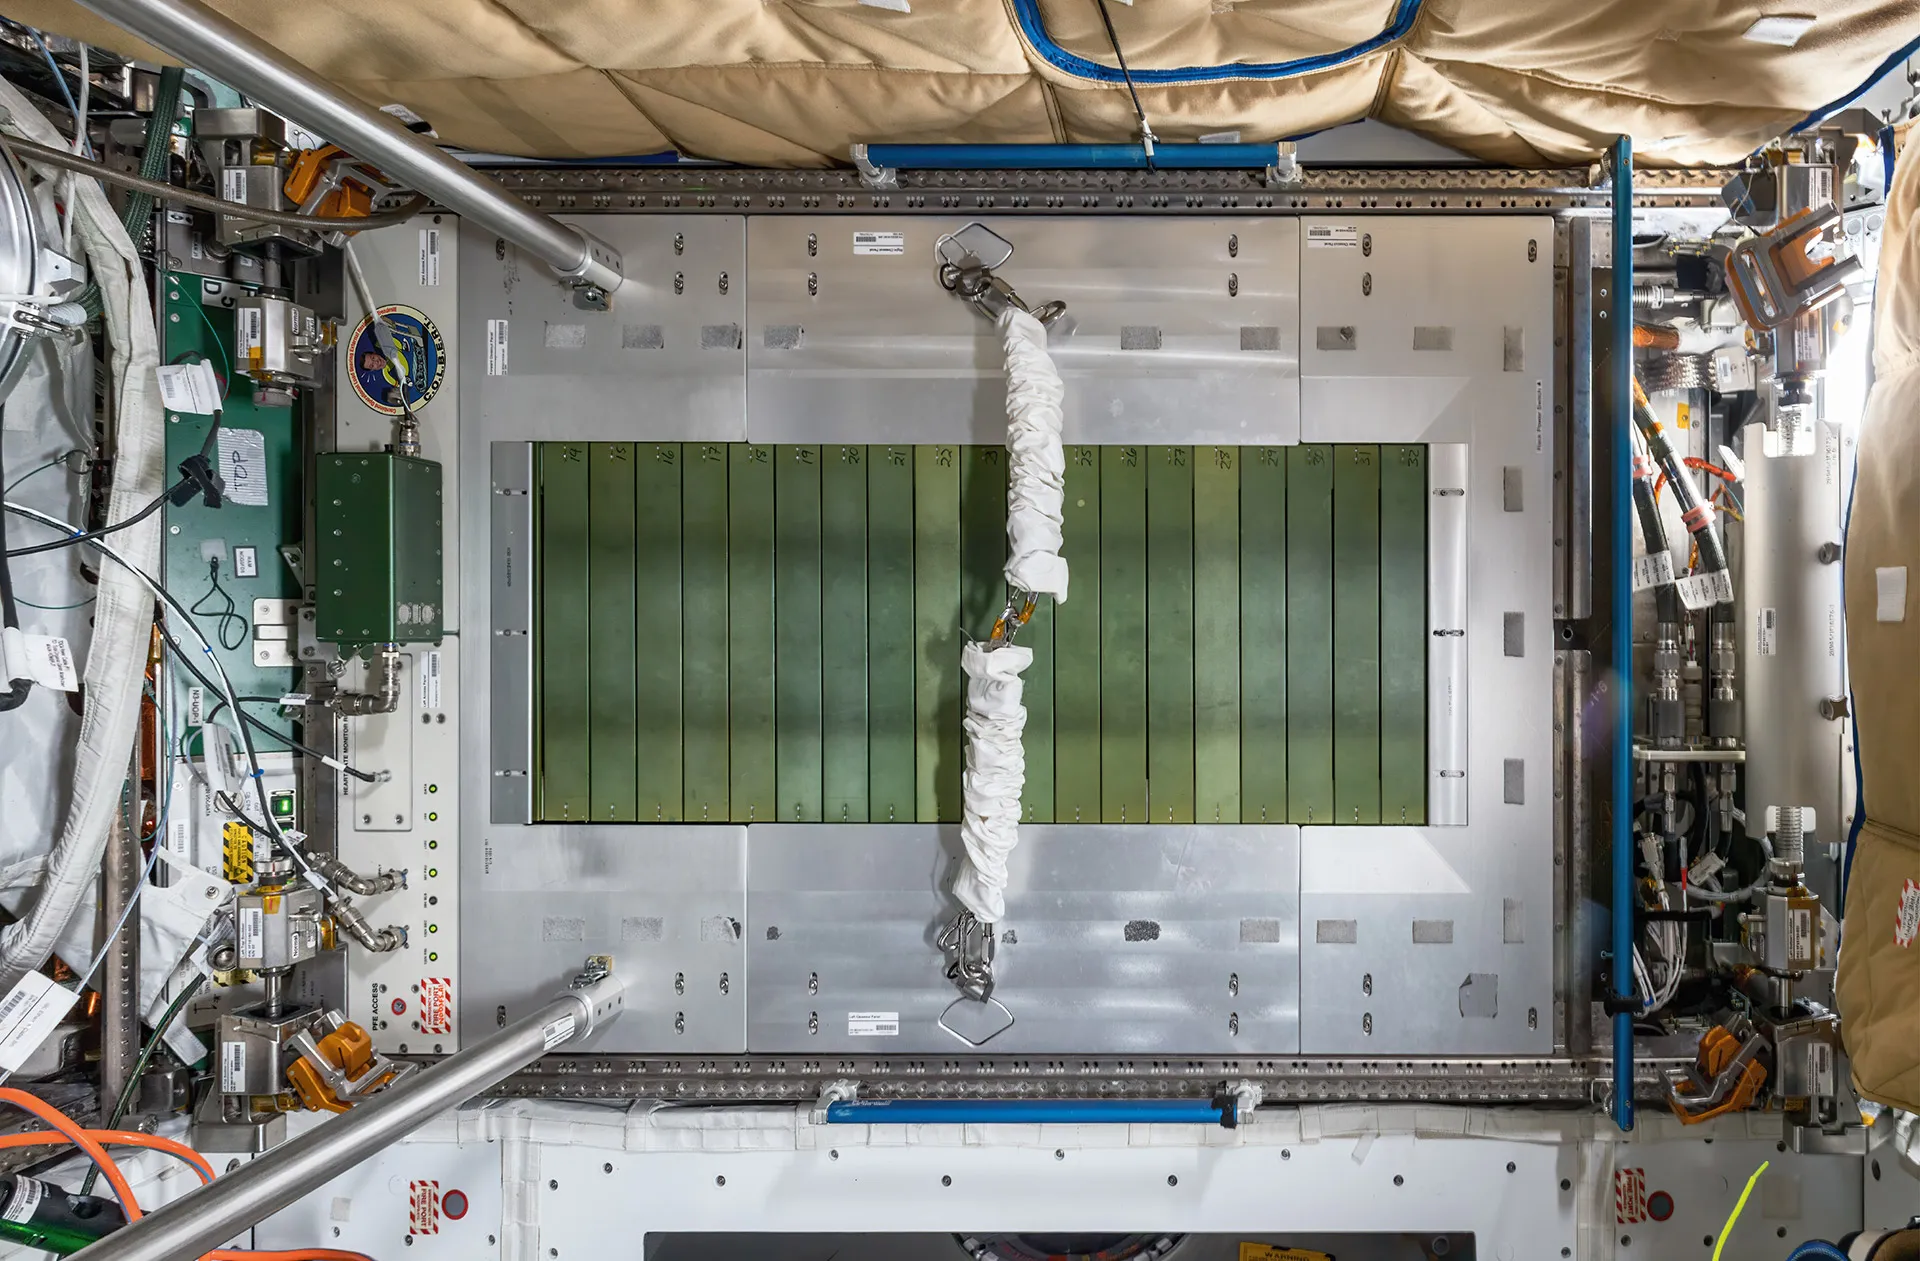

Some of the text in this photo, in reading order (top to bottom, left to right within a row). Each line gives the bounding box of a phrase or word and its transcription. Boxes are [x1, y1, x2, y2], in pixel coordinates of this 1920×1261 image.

[204, 280, 222, 294] D
[349, 332, 361, 353] External
[423, 317, 445, 402] C.O.L.B.E.R.T.
[350, 372, 360, 384] Load
[355, 384, 375, 406] Operational
[662, 450, 674, 464] 16
[710, 447, 721, 462] 17
[756, 450, 767, 464] 18
[802, 450, 813, 464] 19
[848, 447, 860, 464] 20
[895, 452, 906, 466] 21
[940, 448, 952, 466] 22
[1081, 448, 1092, 466] 25
[1128, 448, 1137, 467] 26
[1174, 448, 1185, 466] 27
[1360, 448, 1371, 465] 31
[1408, 448, 1420, 467] 32
